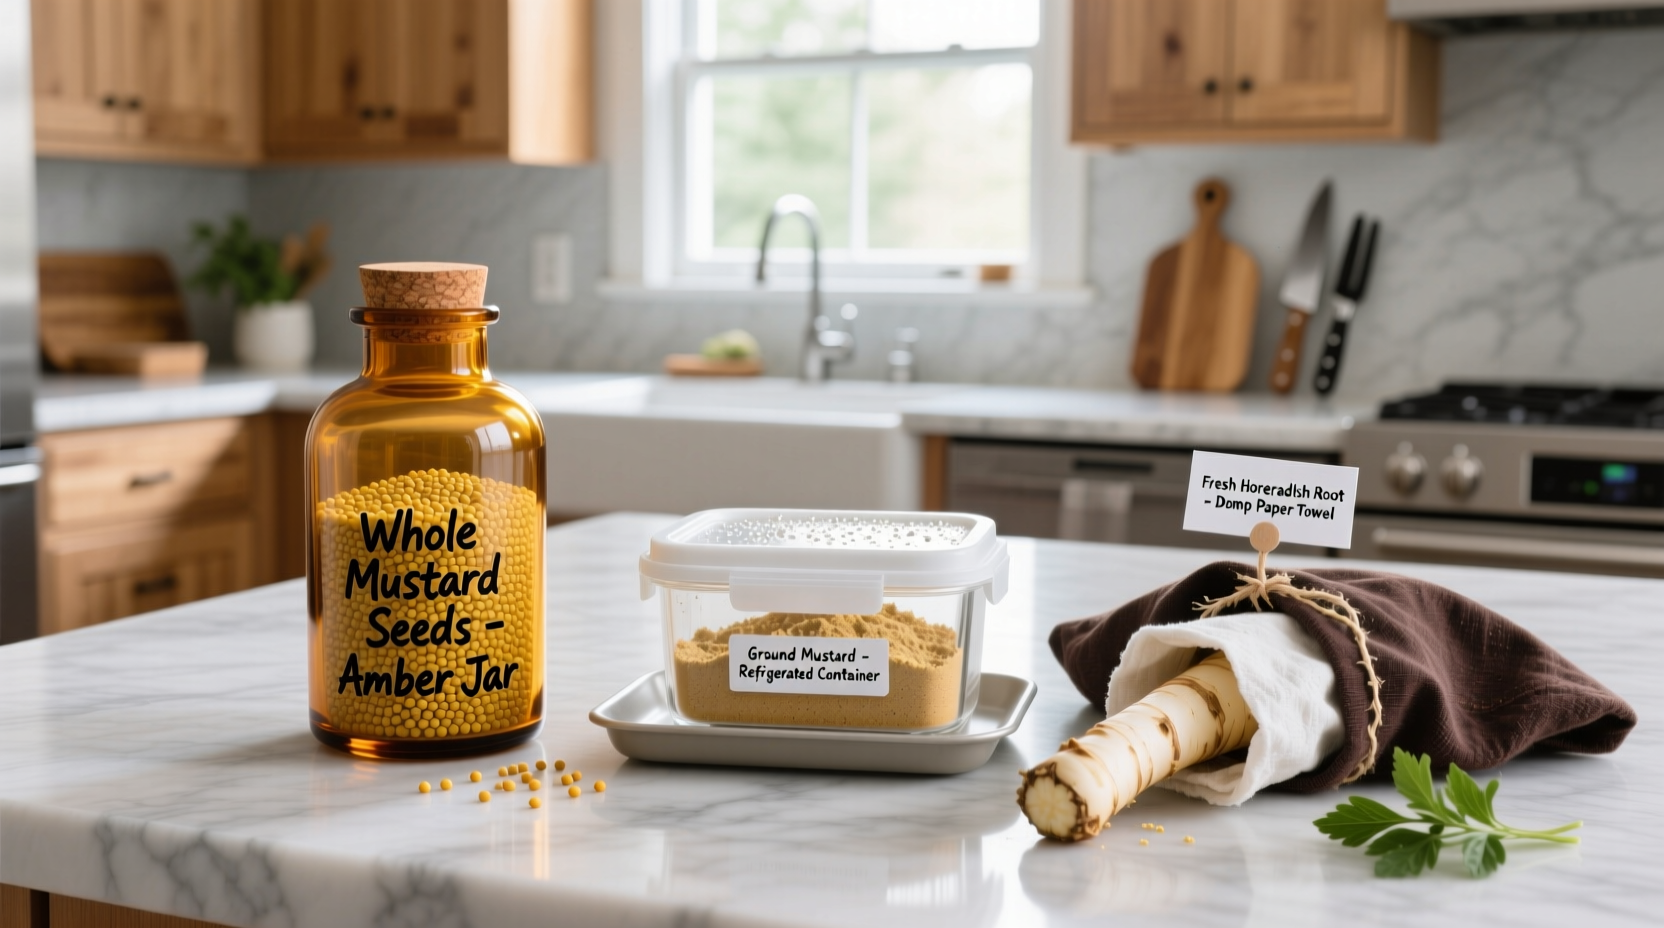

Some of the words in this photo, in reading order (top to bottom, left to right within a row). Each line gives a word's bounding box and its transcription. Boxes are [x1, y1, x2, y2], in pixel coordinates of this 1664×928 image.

[1202, 475, 1236, 491] Fresh
[1313, 486, 1345, 502] Root
[1256, 498, 1294, 518] Paper
[1297, 503, 1335, 520] Towel
[360, 508, 477, 553] Whole
[345, 552, 501, 601] Mustard
[366, 604, 471, 648] Seeds
[485, 620, 504, 630] -
[748, 646, 796, 661] Ground
[801, 647, 856, 662] Mustard
[338, 653, 454, 697] Amber
[461, 654, 519, 698] Jar
[817, 667, 880, 682] Container
